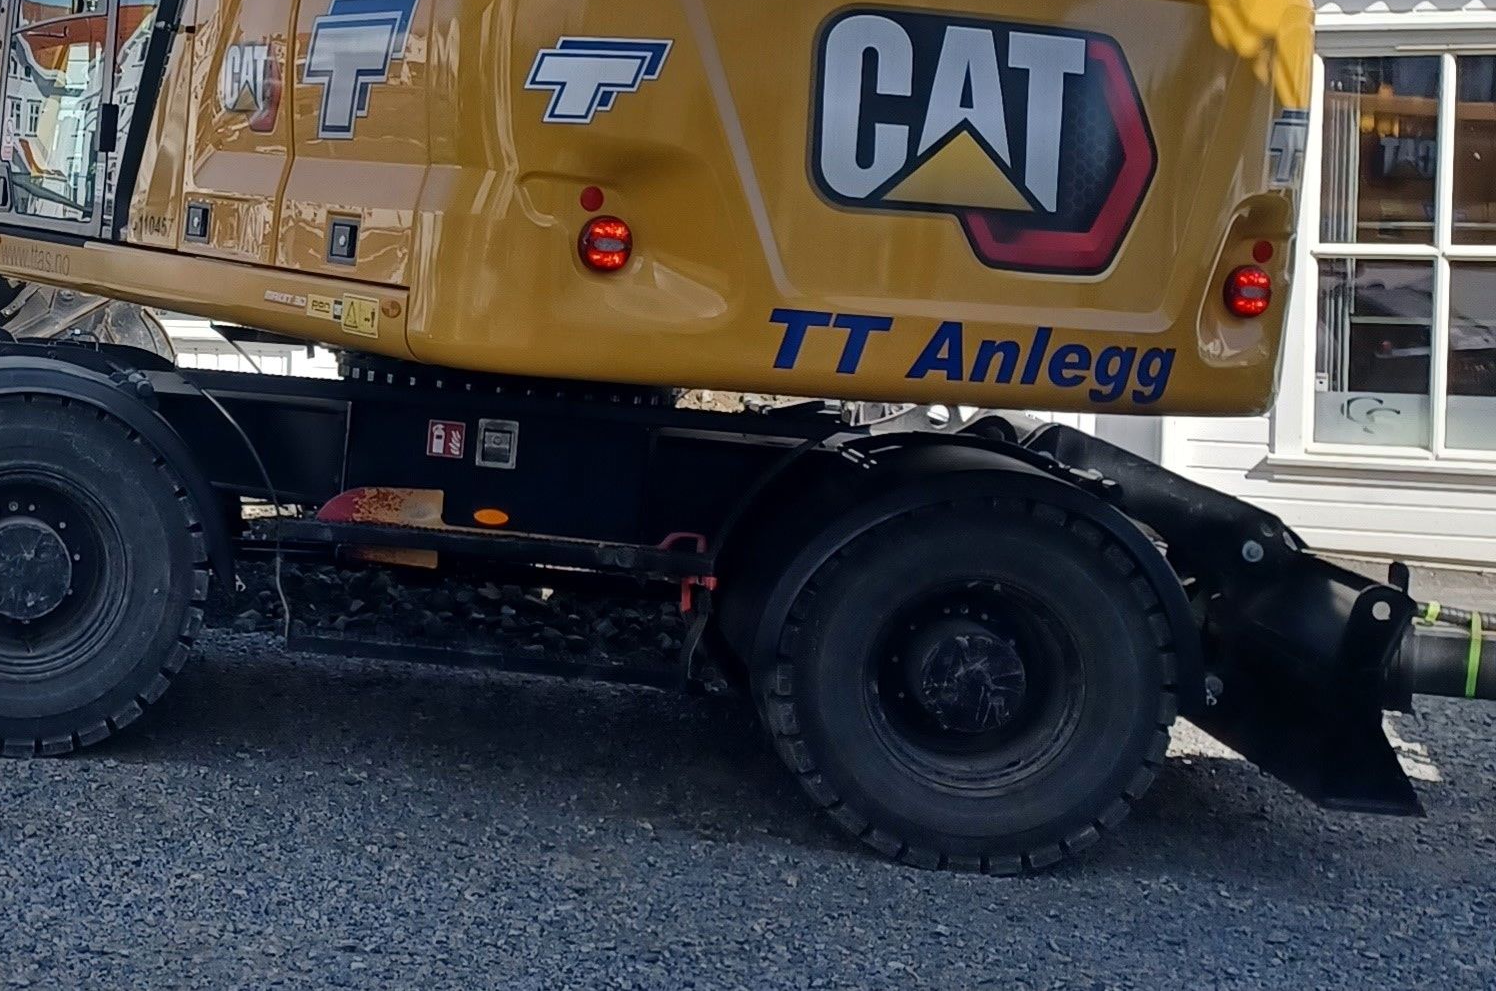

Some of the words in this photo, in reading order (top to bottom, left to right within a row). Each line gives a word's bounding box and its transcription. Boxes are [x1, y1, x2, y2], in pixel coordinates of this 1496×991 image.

[224, 43, 269, 111] CAT
[820, 13, 1087, 214] CAT
[769, 308, 894, 376] TT
[904, 320, 1177, 404] Anlegg
